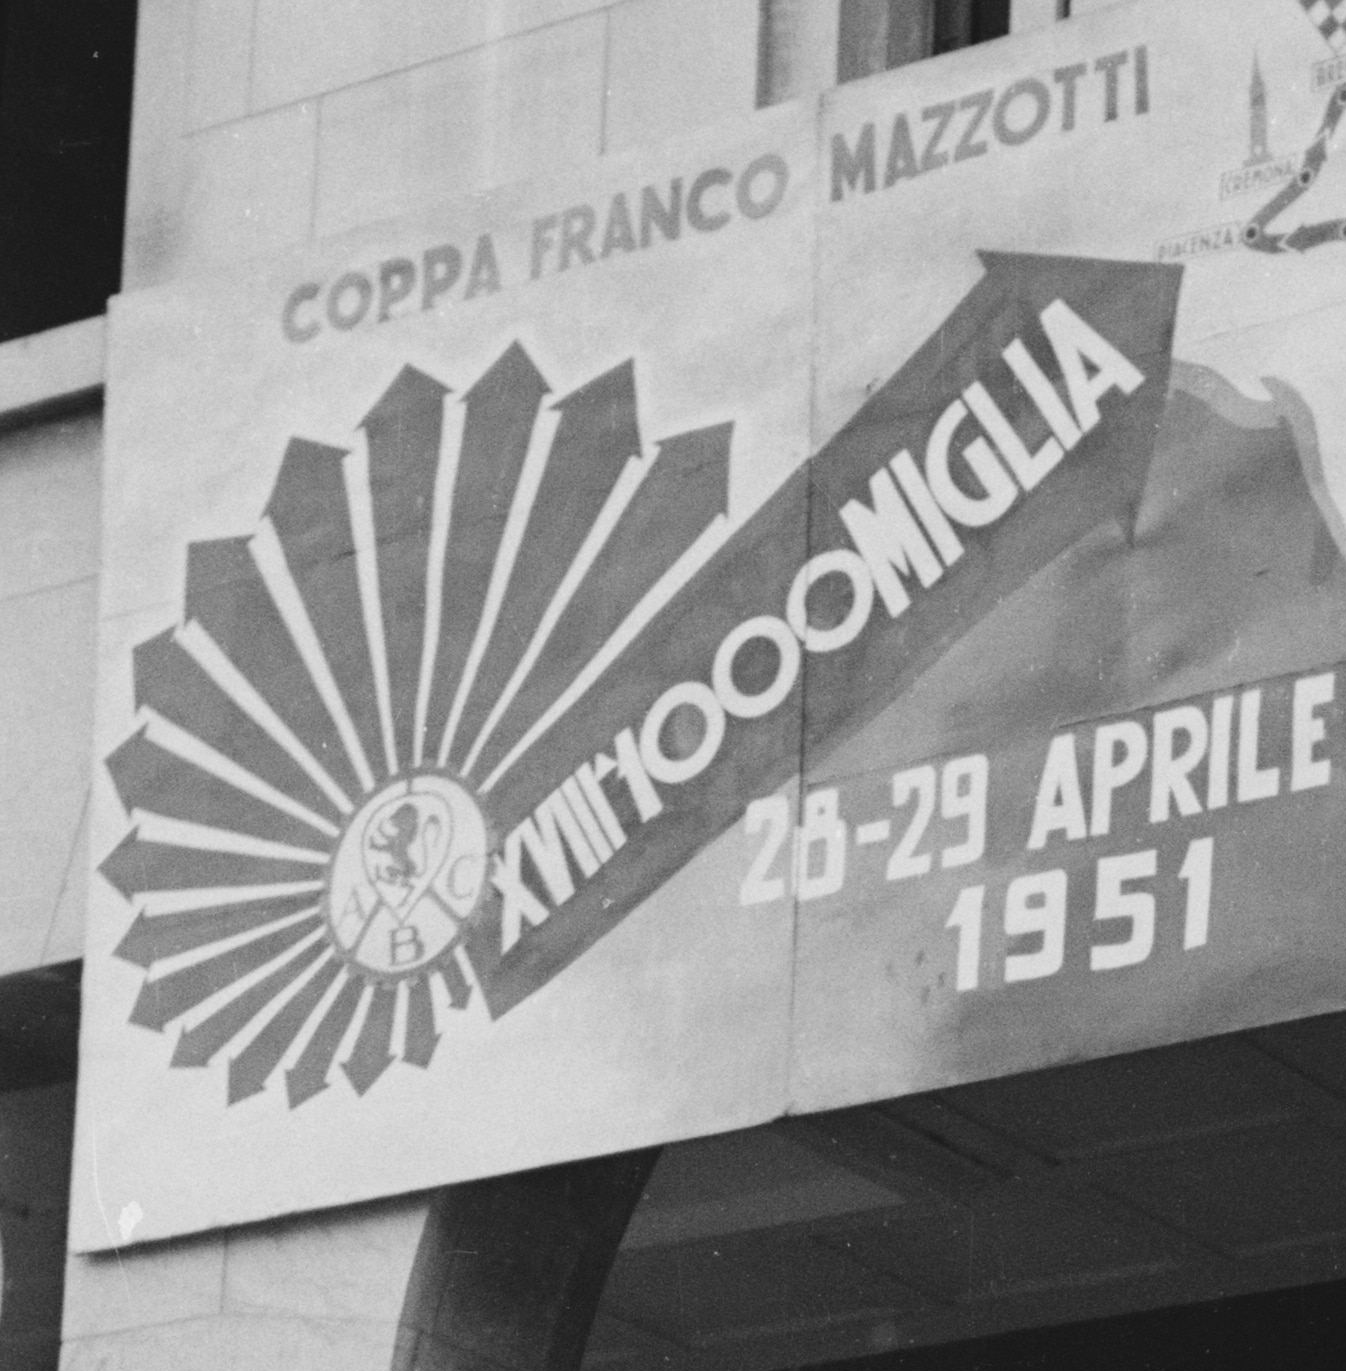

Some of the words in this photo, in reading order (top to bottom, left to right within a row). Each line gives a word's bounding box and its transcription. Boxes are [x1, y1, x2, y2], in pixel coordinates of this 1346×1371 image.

[281, 234, 502, 345] COPPA
[528, 153, 790, 281] FRANCO
[830, 46, 1150, 202] MAZZOTTI
[1158, 229, 1234, 261] PIACENZA
[738, 754, 990, 906] 28-29
[1027, 673, 1336, 850] APRILE
[945, 838, 1214, 992] 1951
